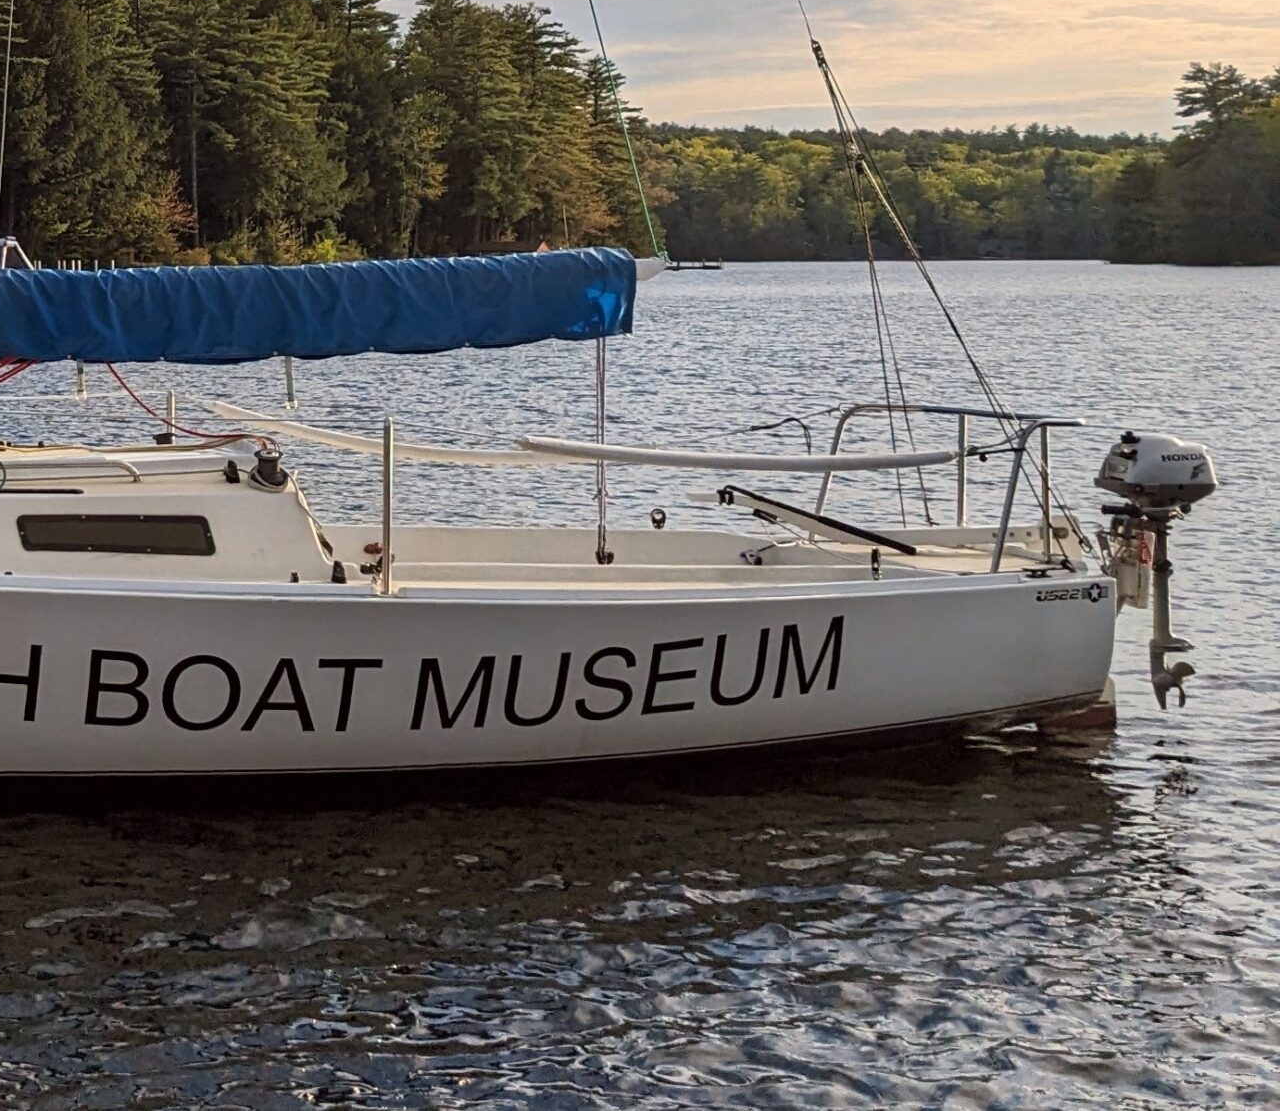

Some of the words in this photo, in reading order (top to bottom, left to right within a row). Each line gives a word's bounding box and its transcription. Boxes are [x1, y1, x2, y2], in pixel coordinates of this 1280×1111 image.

[1160, 453, 1207, 463] HONDA
[83, 648, 384, 733] BOAT
[409, 614, 845, 731] MUSEUM
